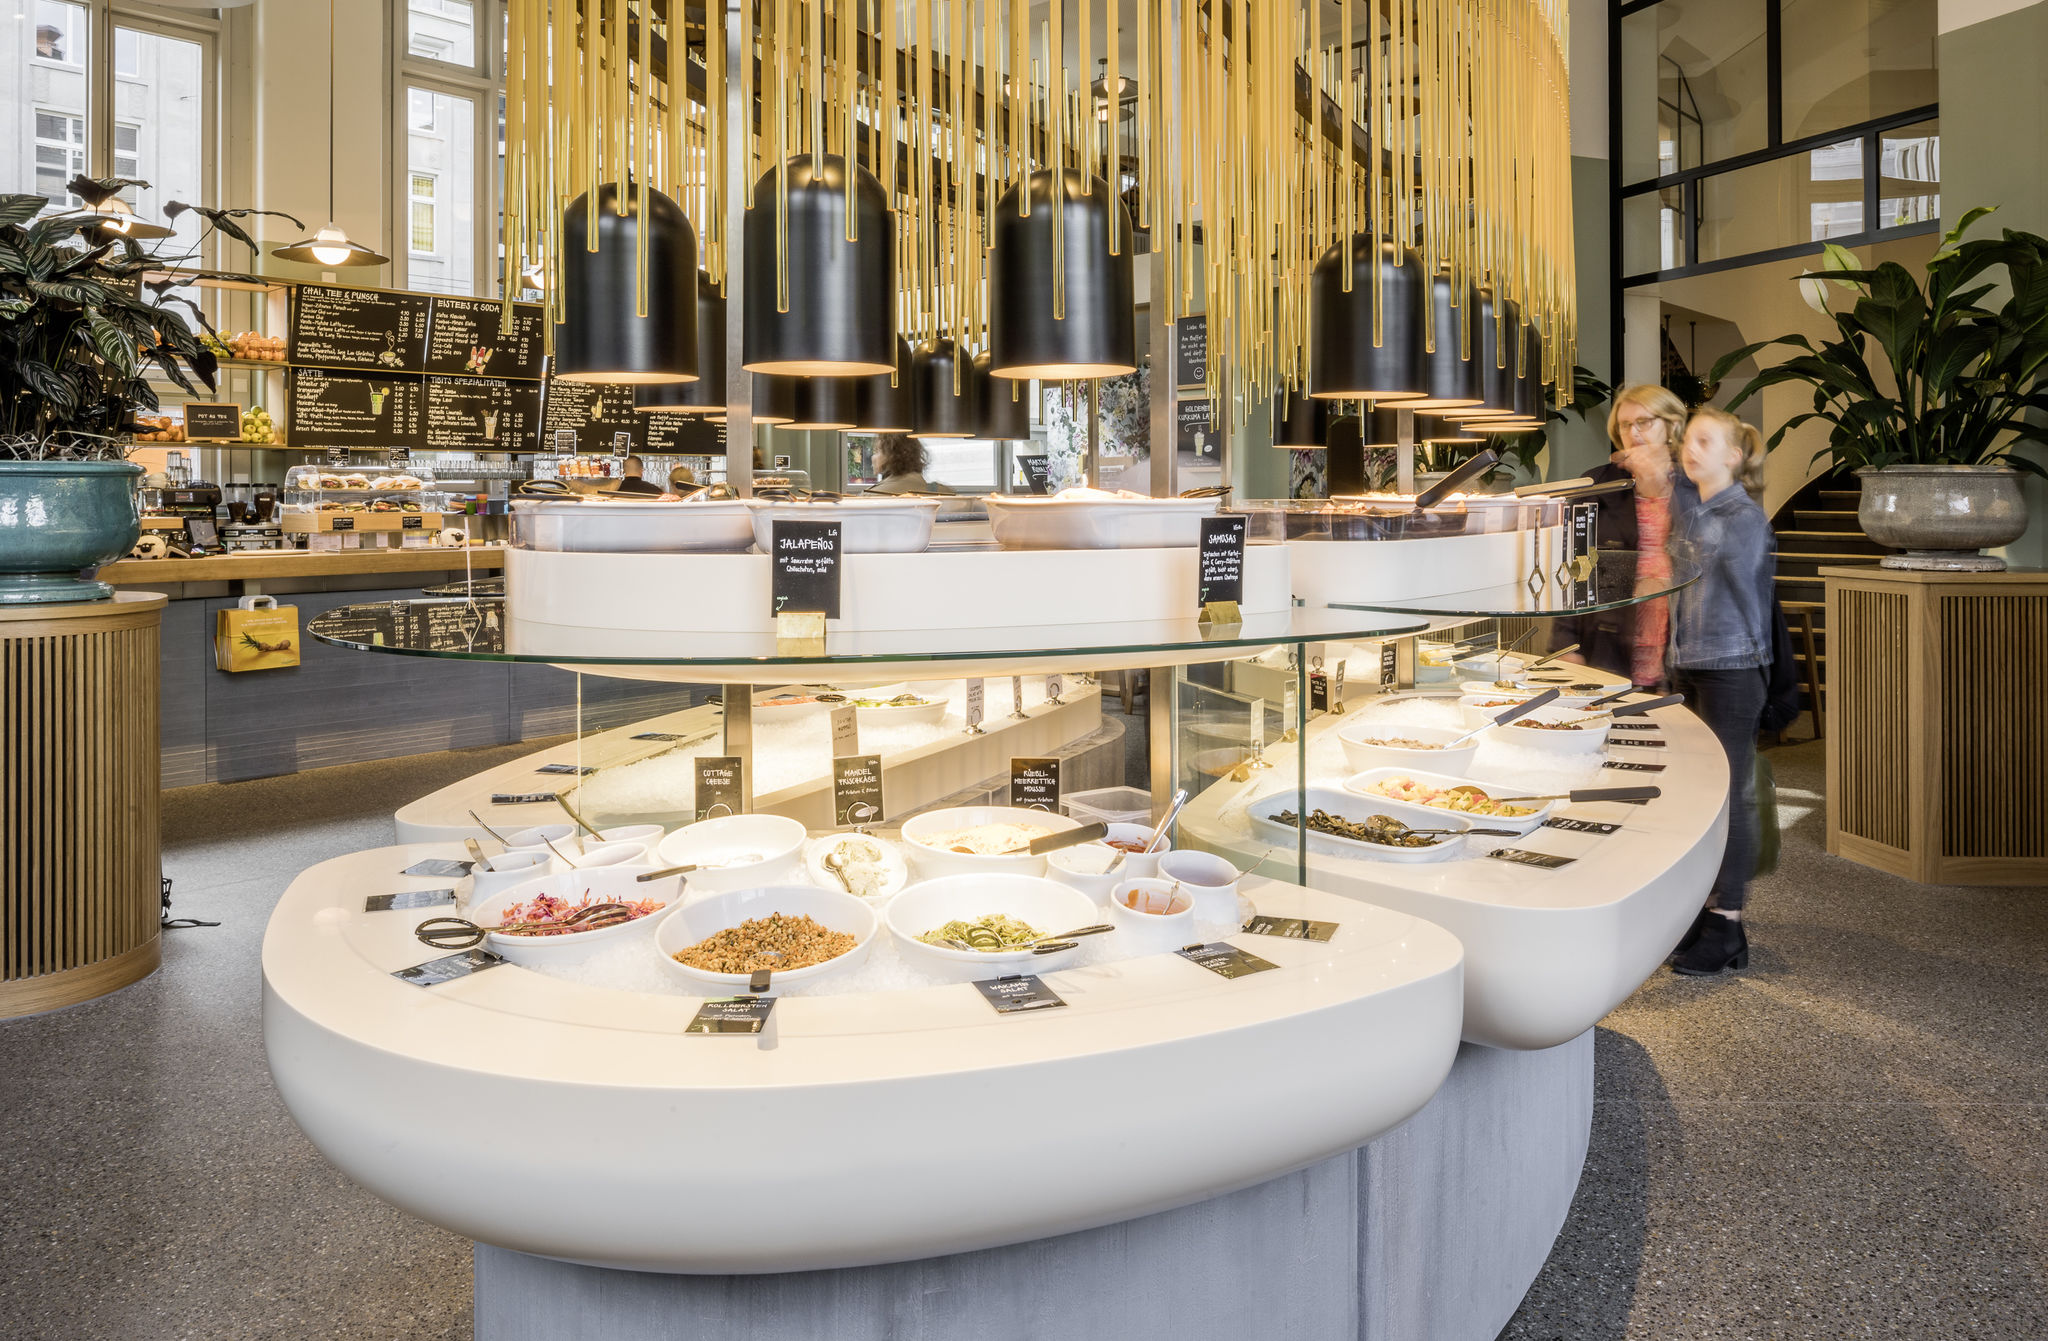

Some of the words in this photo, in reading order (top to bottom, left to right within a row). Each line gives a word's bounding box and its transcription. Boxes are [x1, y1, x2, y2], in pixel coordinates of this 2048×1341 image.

[303, 287, 323, 296] CHAI,
[352, 291, 379, 302] PUNSCH
[438, 300, 470, 310] EISTEES
[480, 304, 499, 313] SODA
[430, 376, 451, 385] TIBITS
[1209, 534, 1236, 544] SAMOSAS
[780, 537, 833, 551] JALAPEÑOS
[703, 769, 733, 777] COTTAGE
[844, 769, 872, 777] MANDEL
[1024, 768, 1048, 777] RÜEBLI-
[706, 778, 731, 786] CHEESE
[838, 775, 877, 786] FRISCHKÄSE
